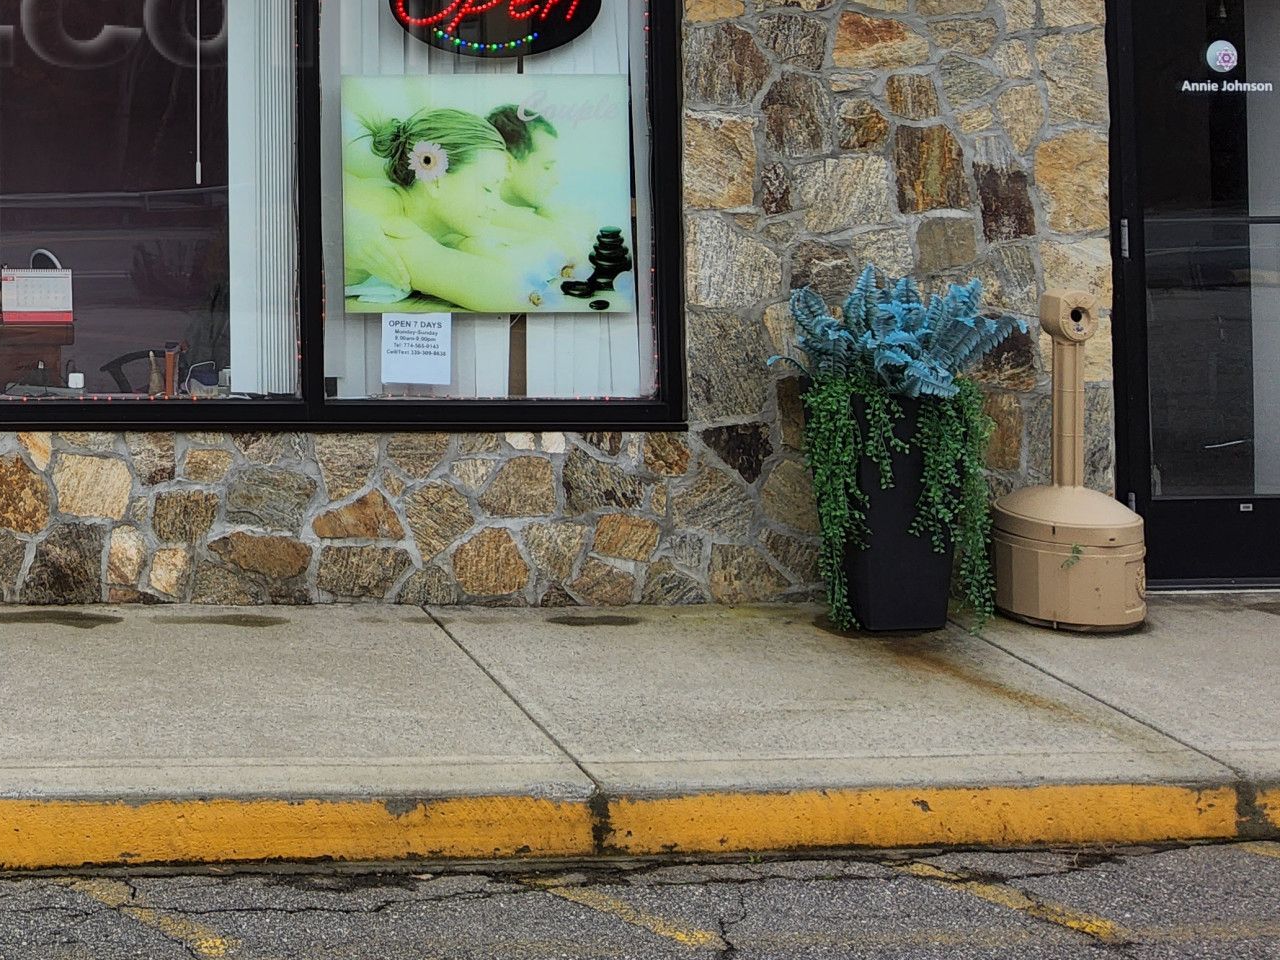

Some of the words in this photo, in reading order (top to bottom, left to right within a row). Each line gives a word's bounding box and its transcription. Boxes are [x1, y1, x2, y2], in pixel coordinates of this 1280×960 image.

[1181, 80, 1219, 92] Annie
[1221, 80, 1273, 92] Johnson
[388, 320, 411, 328] OPEN
[420, 321, 443, 329] DAYS
